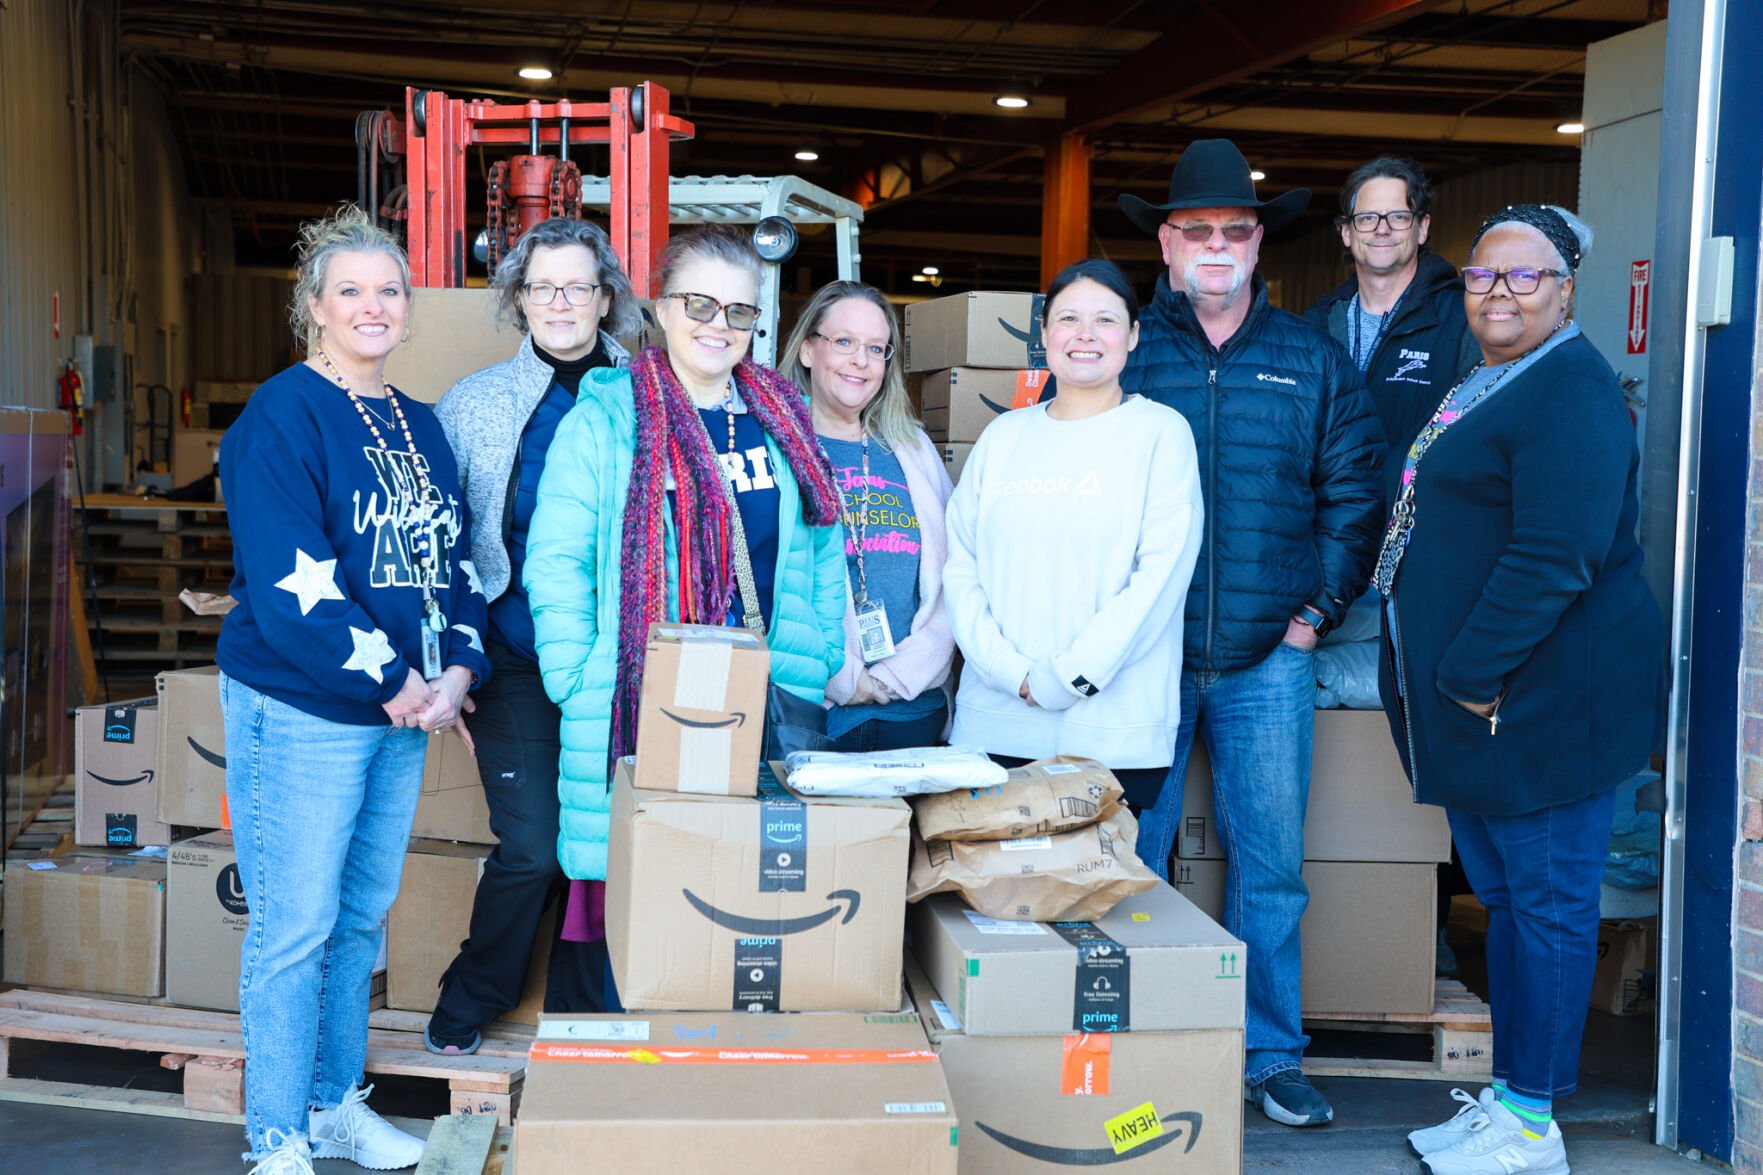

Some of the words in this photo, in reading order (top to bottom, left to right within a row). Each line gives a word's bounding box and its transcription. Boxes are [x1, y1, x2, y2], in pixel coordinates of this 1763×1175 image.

[1634, 269, 1647, 282] FIRE
[1399, 349, 1430, 360] PARIS
[1264, 374, 1297, 385] Columbia
[363, 446, 443, 504] WE
[843, 492, 904, 509] CHOOL
[839, 509, 921, 529] UNSELOR
[106, 731, 131, 741] prime
[766, 820, 802, 834] prime
[108, 834, 132, 843] prime
[1076, 859, 1113, 873] RUM7
[740, 936, 776, 948] prime
[1082, 1011, 1118, 1025] prime
[1112, 1111, 1159, 1145] HEAVY
